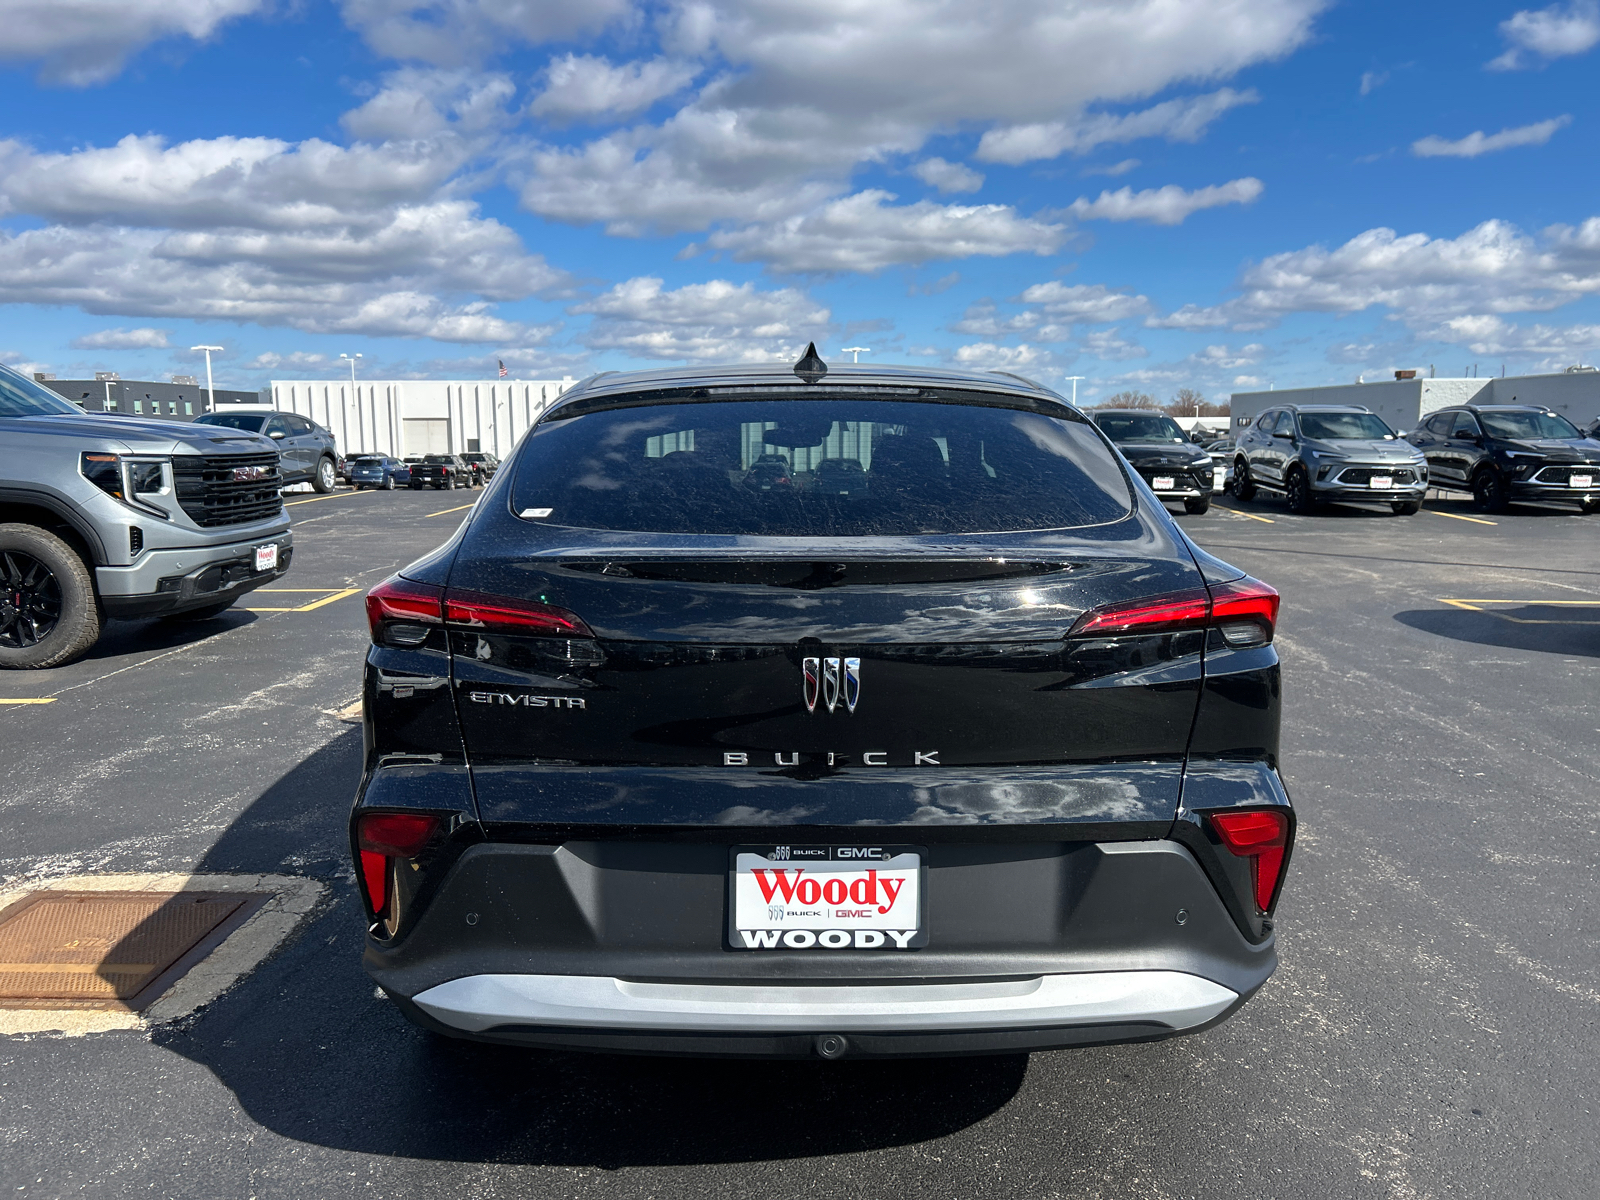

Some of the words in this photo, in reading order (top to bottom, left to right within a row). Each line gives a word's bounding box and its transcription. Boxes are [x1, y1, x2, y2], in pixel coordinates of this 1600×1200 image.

[469, 691, 586, 709] ENVISTA
[723, 751, 941, 766] BUICK
[837, 847, 883, 858] GMC
[750, 868, 906, 915] Woody
[835, 909, 873, 918] GMC
[739, 929, 918, 949] WOODY
